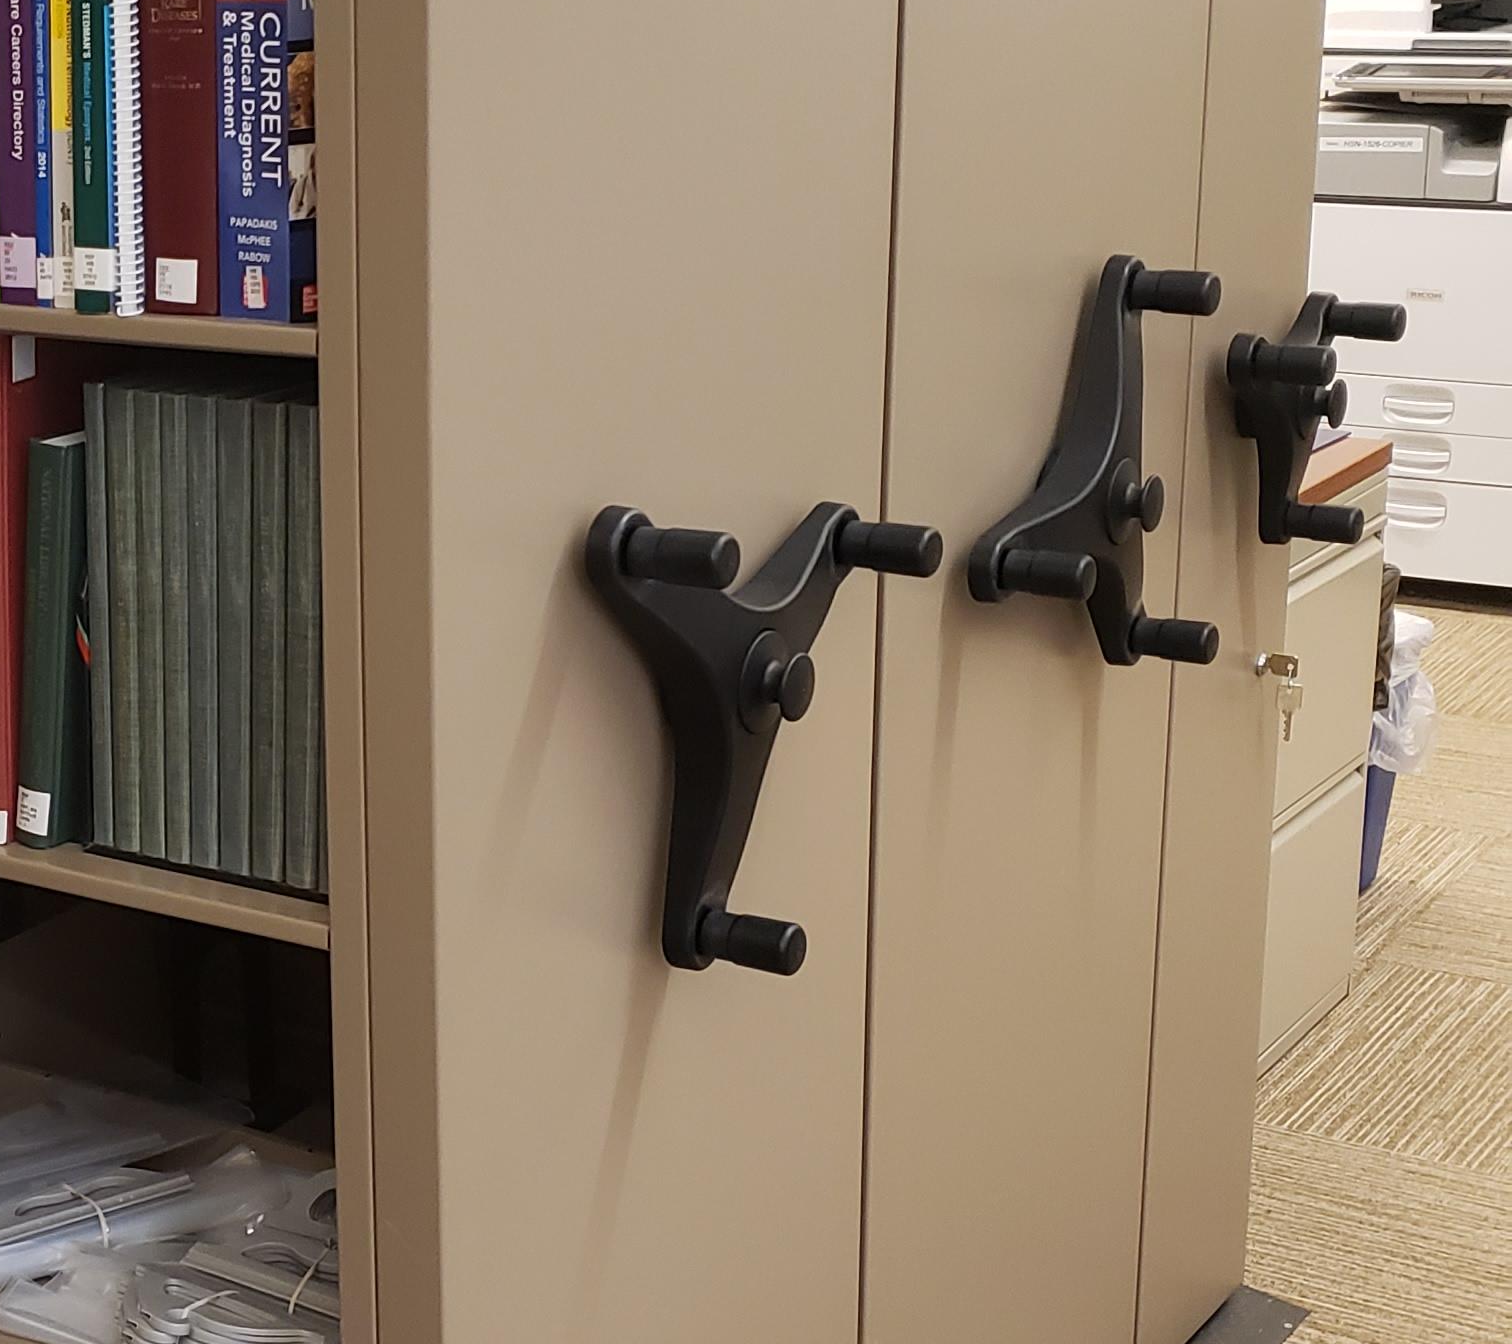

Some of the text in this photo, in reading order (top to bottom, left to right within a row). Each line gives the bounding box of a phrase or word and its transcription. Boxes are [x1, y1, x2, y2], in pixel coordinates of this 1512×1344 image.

[10, 24, 23, 85] Careers
[81, 2, 91, 59] STEDMAN'S
[35, 76, 45, 97] and
[223, 11, 237, 139] & Treatment
[259, 12, 282, 189] CURRENT
[10, 90, 25, 161] Directory
[36, 99, 46, 144] Statistics
[239, 12, 256, 198] Medical Diagnosis
[37, 152, 47, 179] 2014
[230, 216, 278, 231] PAPADAKIS
[237, 234, 271, 247] McPHEE
[238, 250, 271, 264] RABOW
